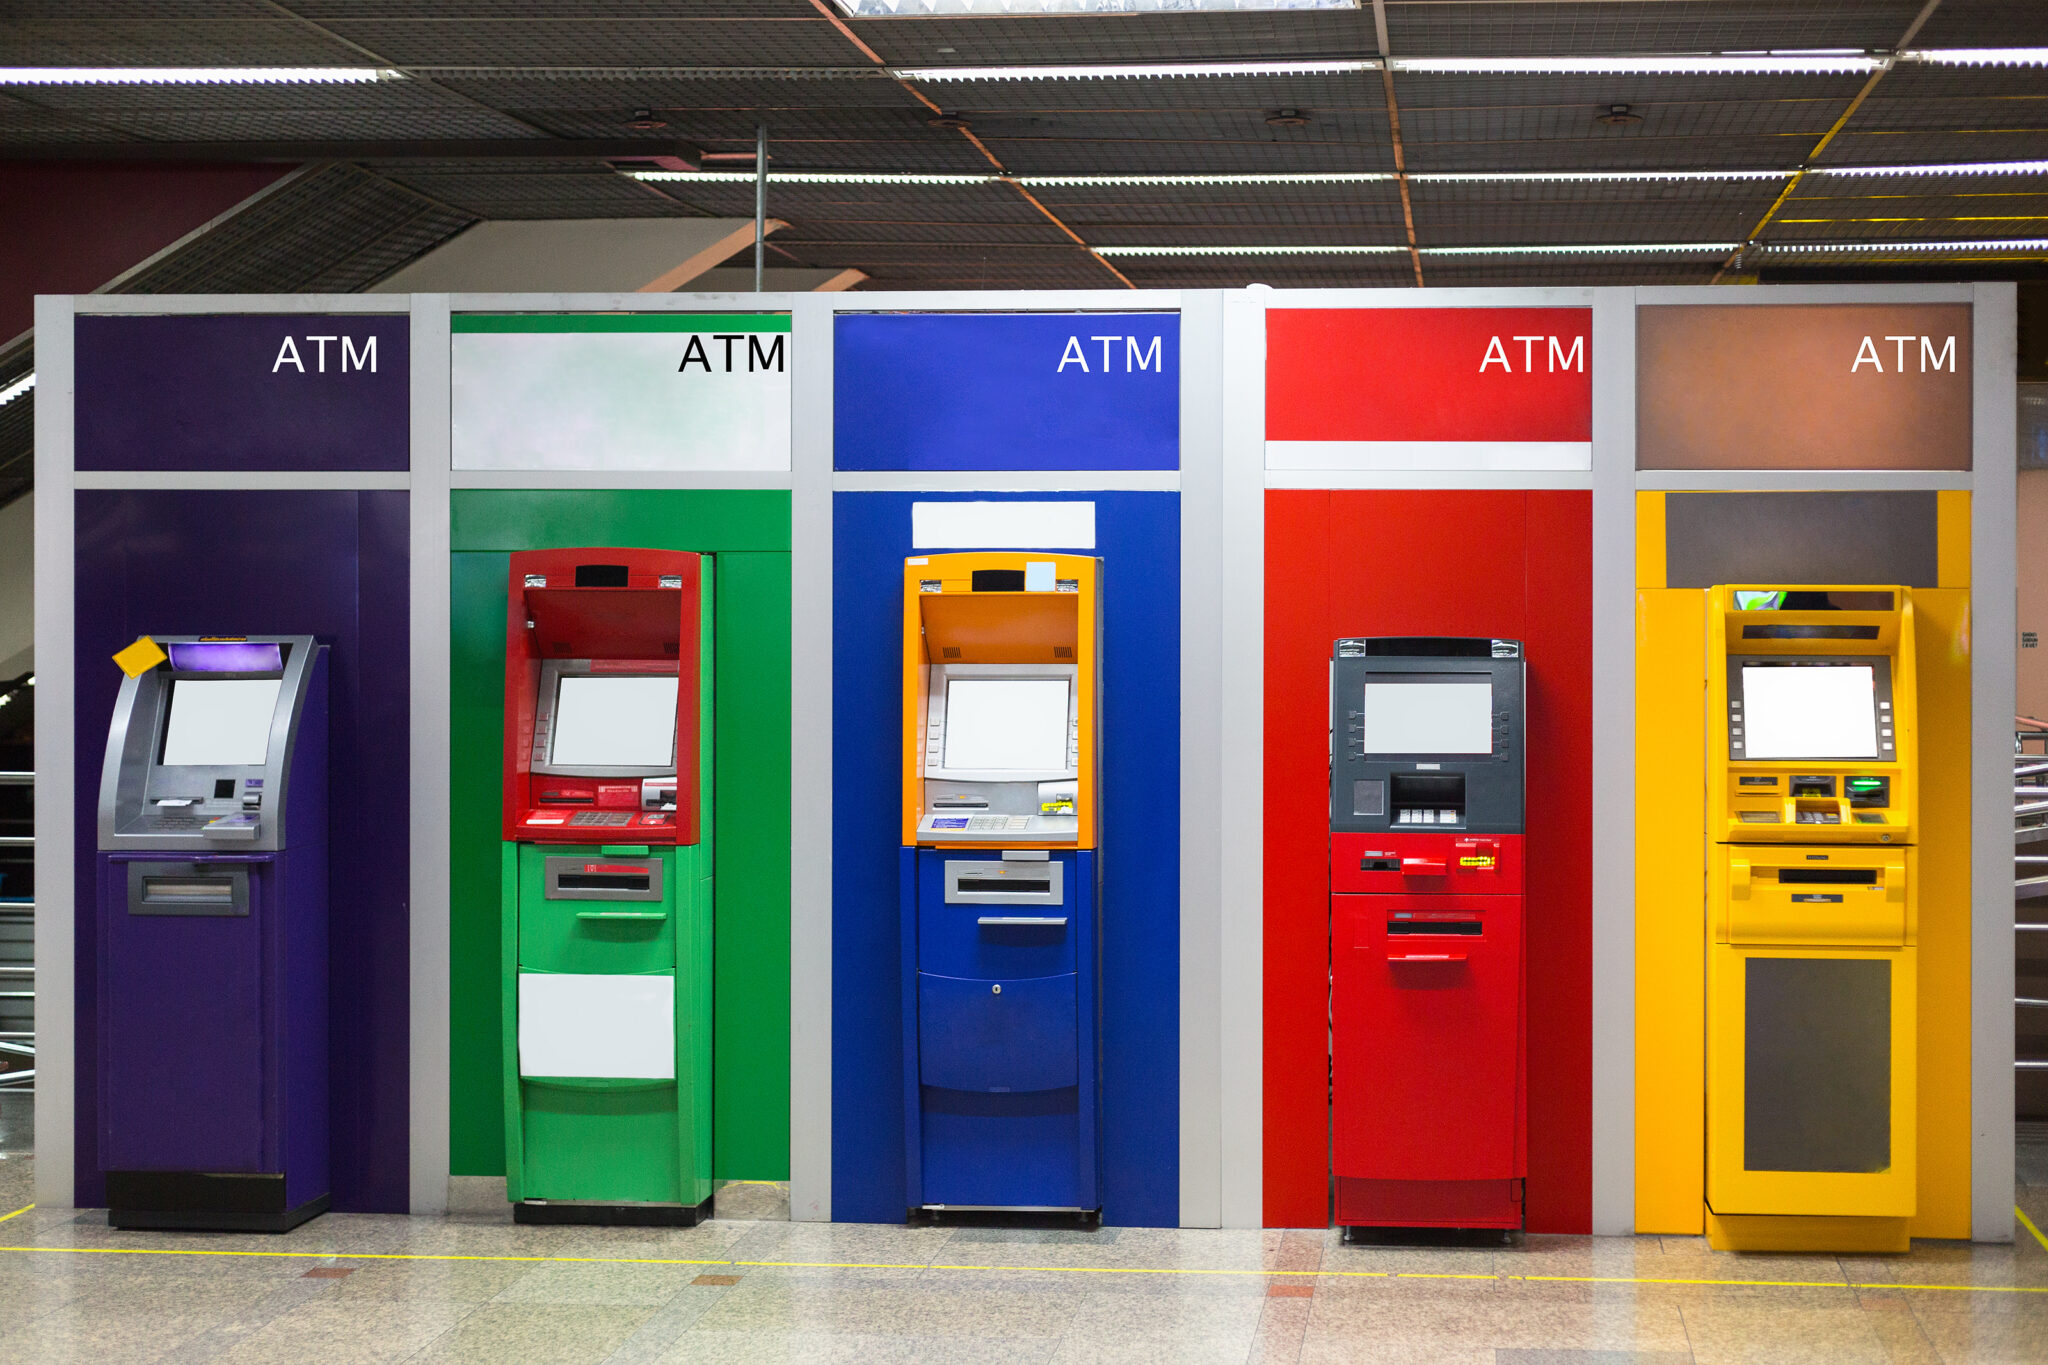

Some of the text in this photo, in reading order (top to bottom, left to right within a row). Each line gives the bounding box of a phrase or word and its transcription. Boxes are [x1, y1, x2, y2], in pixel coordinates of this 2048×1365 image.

[272, 336, 377, 372] ATM
[679, 335, 784, 372] ATM
[1057, 336, 1162, 372] ATM
[1479, 336, 1584, 372] ATM
[1851, 336, 1956, 372] ATM
